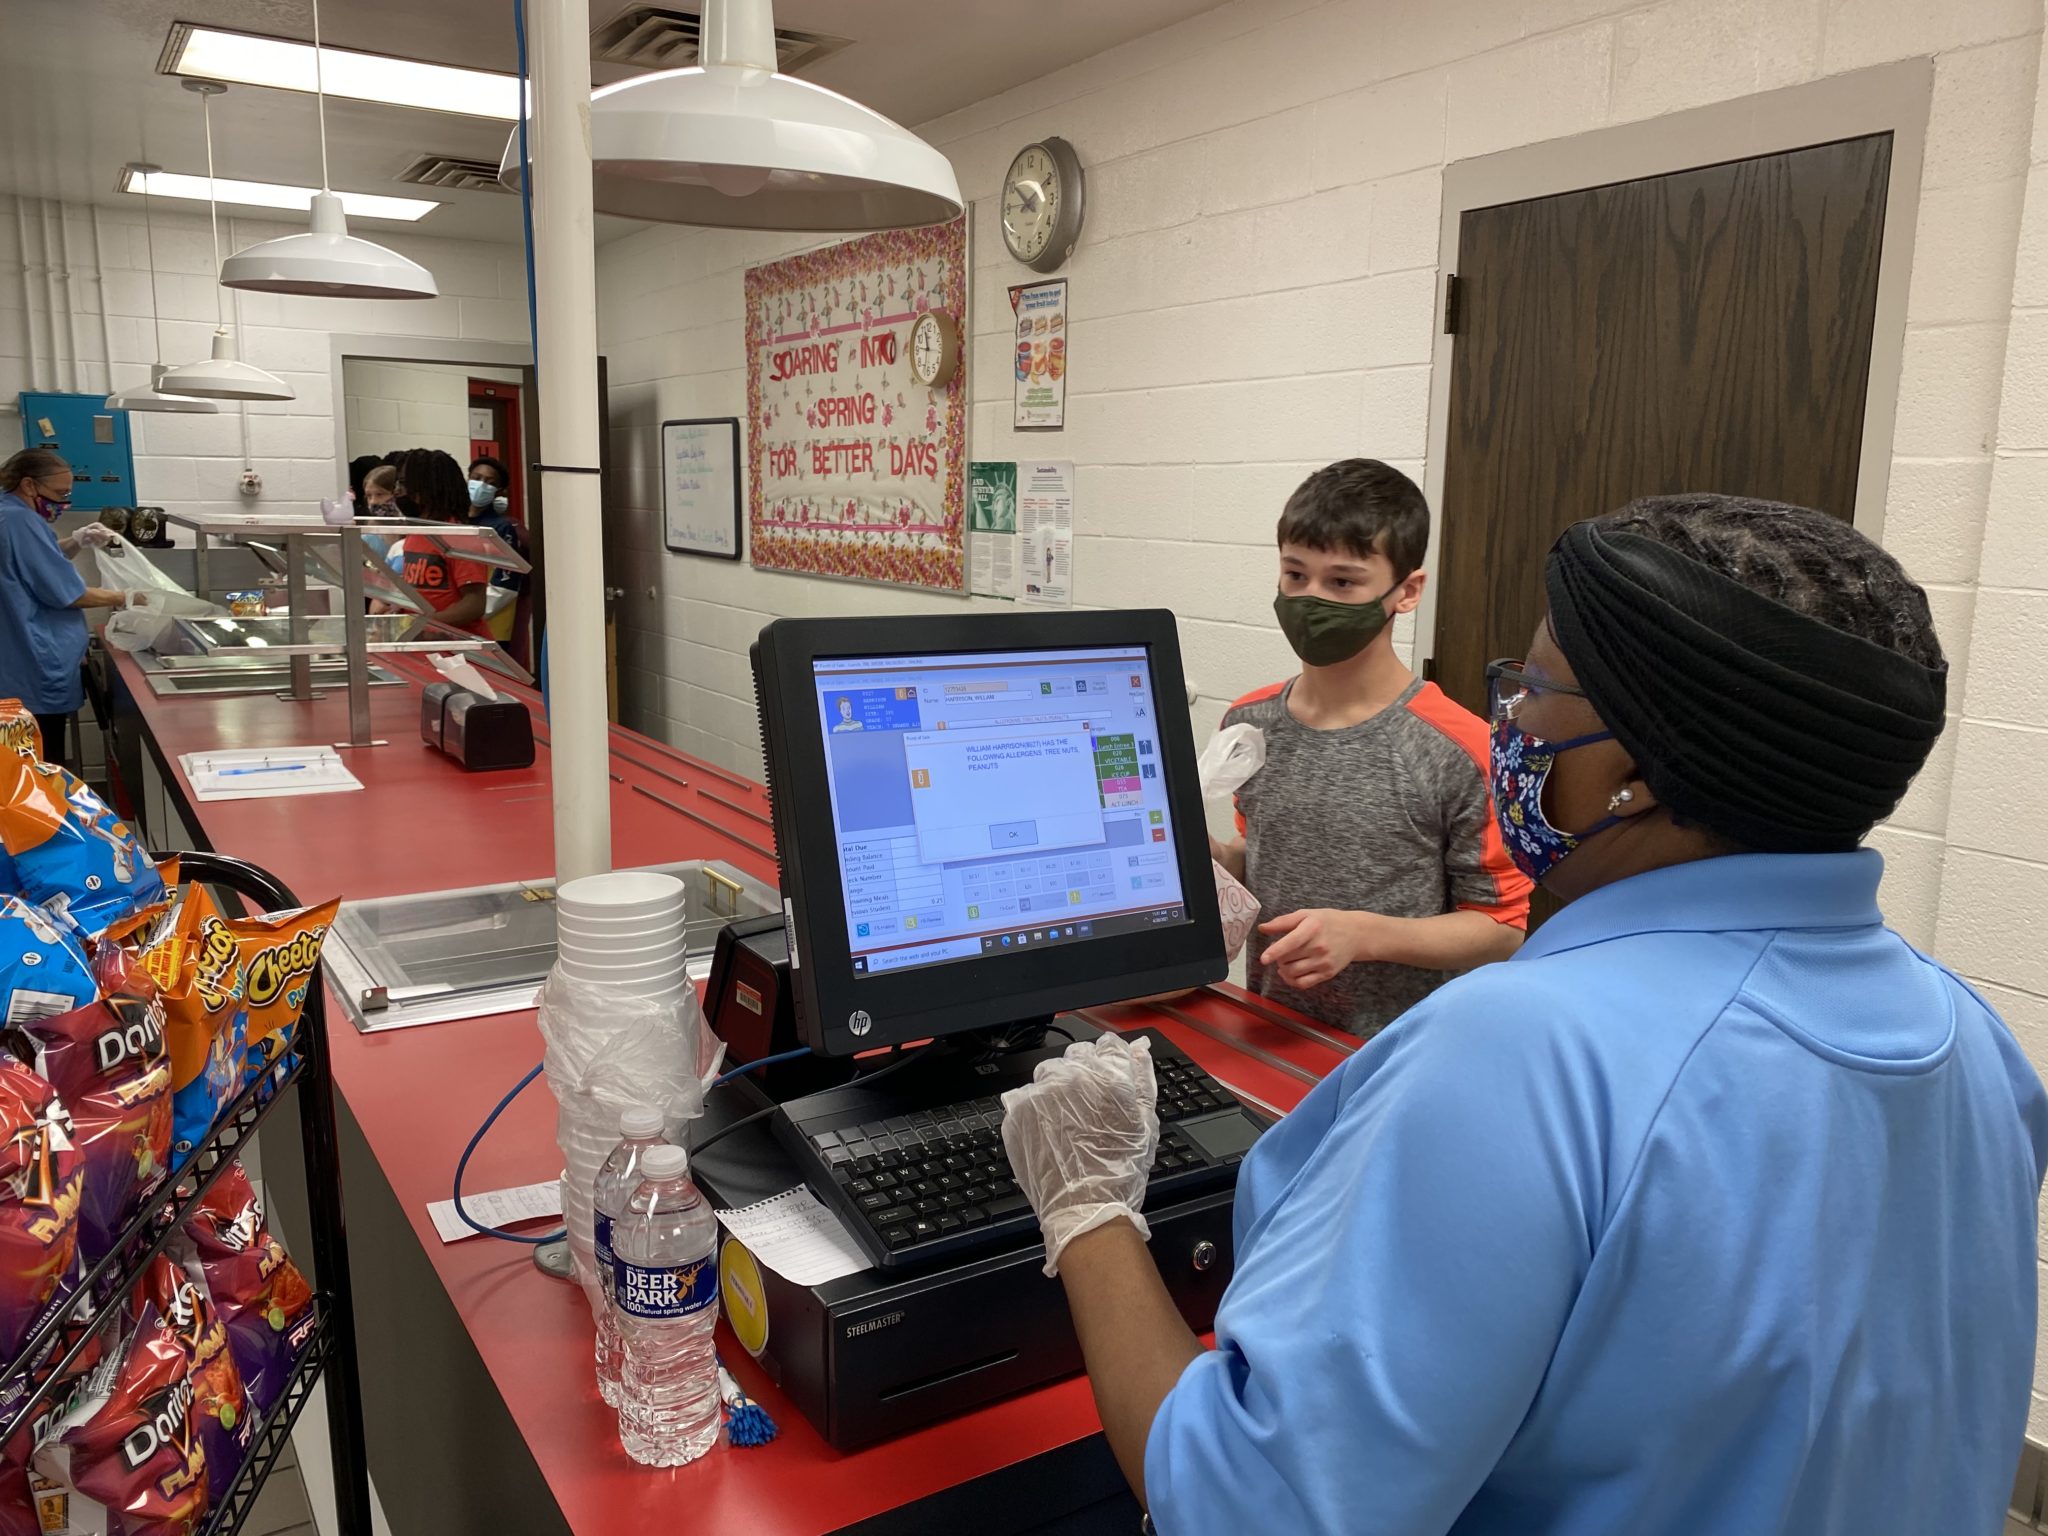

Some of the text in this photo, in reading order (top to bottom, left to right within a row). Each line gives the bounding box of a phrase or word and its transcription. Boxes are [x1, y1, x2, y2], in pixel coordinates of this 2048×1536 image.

[1027, 155, 1034, 169] 12
[1017, 163, 1023, 176] 11
[1007, 181, 1015, 194] 10
[1050, 193, 1054, 206] 3
[1046, 215, 1051, 228] 4
[1038, 232, 1042, 244] 5
[1027, 240, 1031, 253] 6
[769, 331, 896, 381] SOARING INTO
[817, 392, 875, 429] SPRING
[769, 442, 938, 478] FOR BETTER DAYS
[966, 744, 992, 752] WILLIAM
[968, 753, 1004, 762] FOLLOWING
[1045, 748, 1060, 756] TREE
[968, 763, 998, 772] PEANUTS
[882, 956, 898, 964] Search
[930, 950, 941, 958] your
[248, 930, 324, 1002] Cheeto
[899, 1168, 909, 1176] W
[626, 1269, 678, 1289] DEER
[626, 1286, 678, 1307] PARK
[664, 1306, 684, 1315] spring
[684, 1301, 702, 1311] water
[846, 1313, 901, 1338] STEELMASTER
